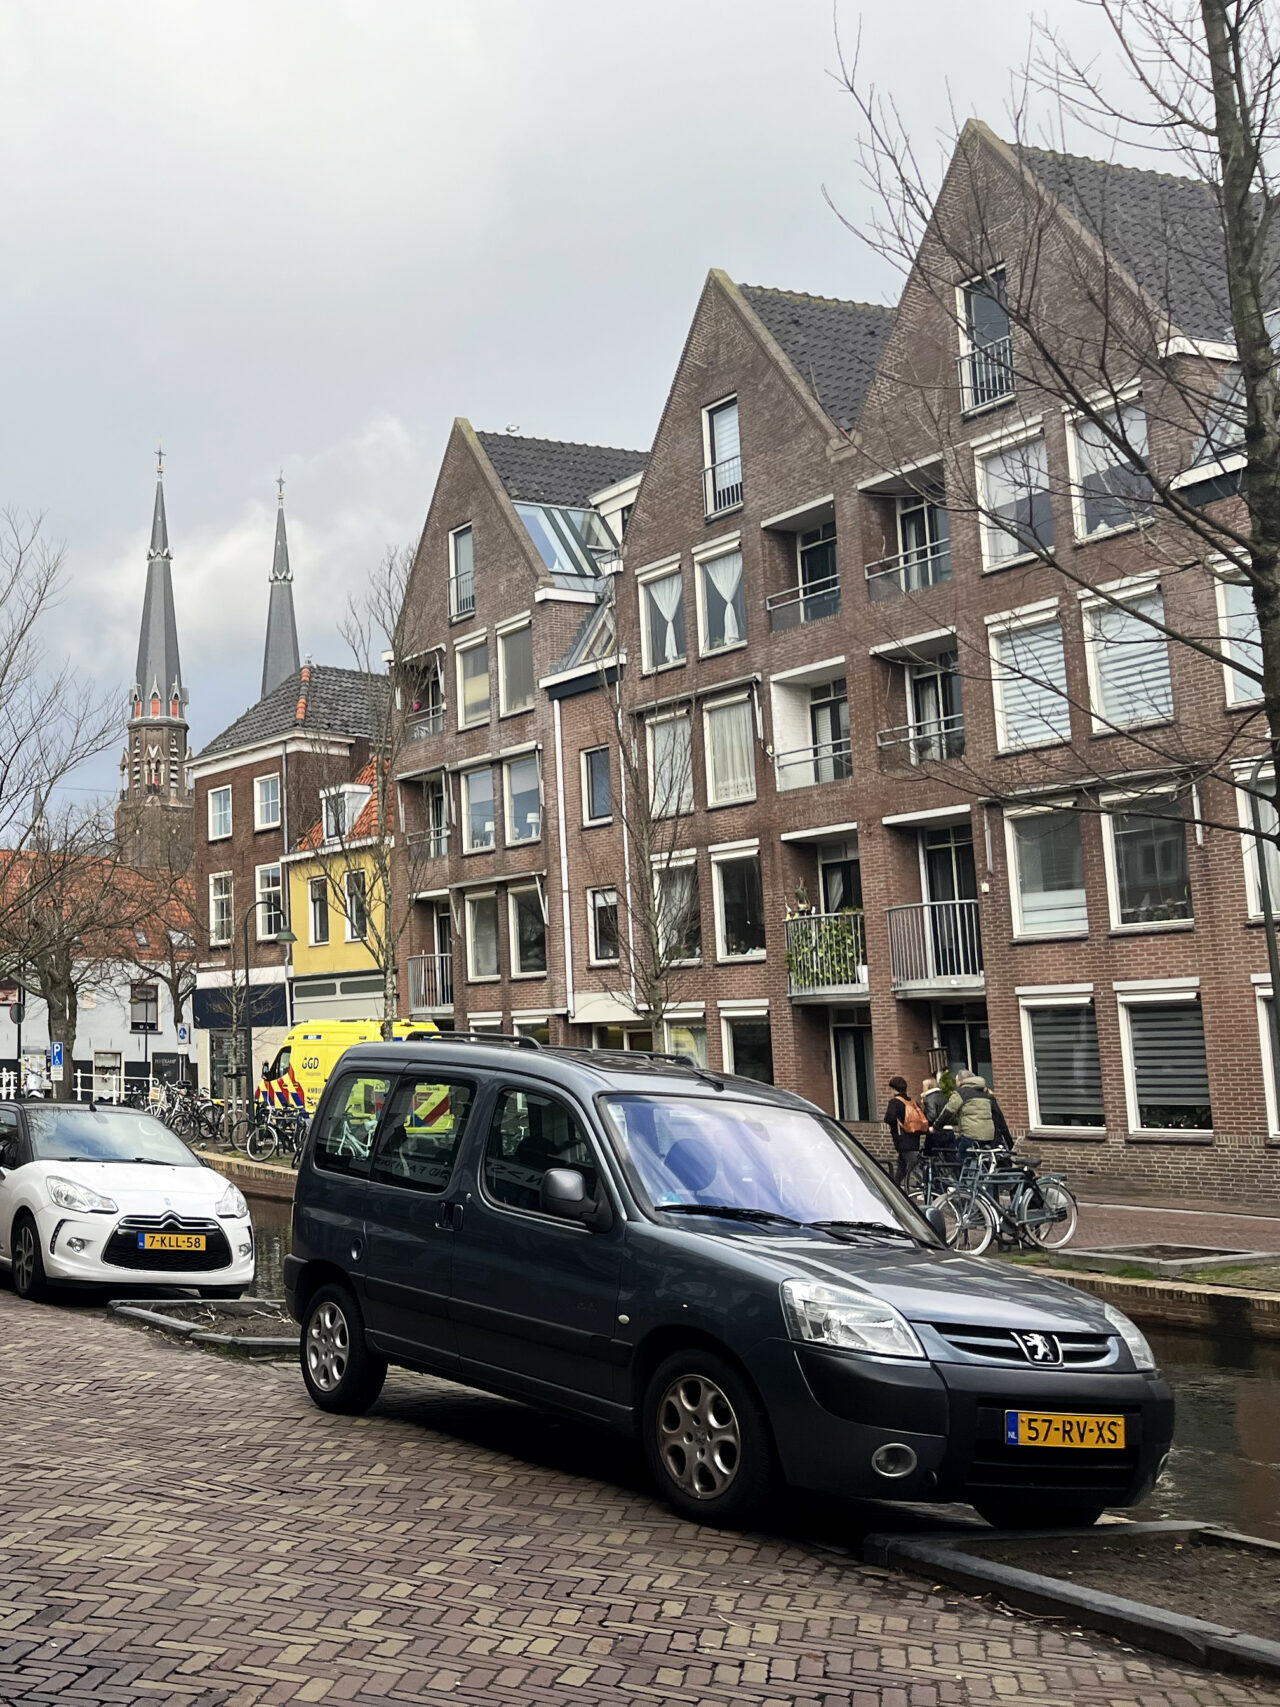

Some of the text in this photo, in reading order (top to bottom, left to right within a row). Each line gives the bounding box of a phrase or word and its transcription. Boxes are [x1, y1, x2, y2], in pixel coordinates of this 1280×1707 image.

[302, 1057, 319, 1069] GGD
[149, 1236, 201, 1249] 7-KLL-58
[1027, 1418, 1118, 1444] 57-RV-XS
